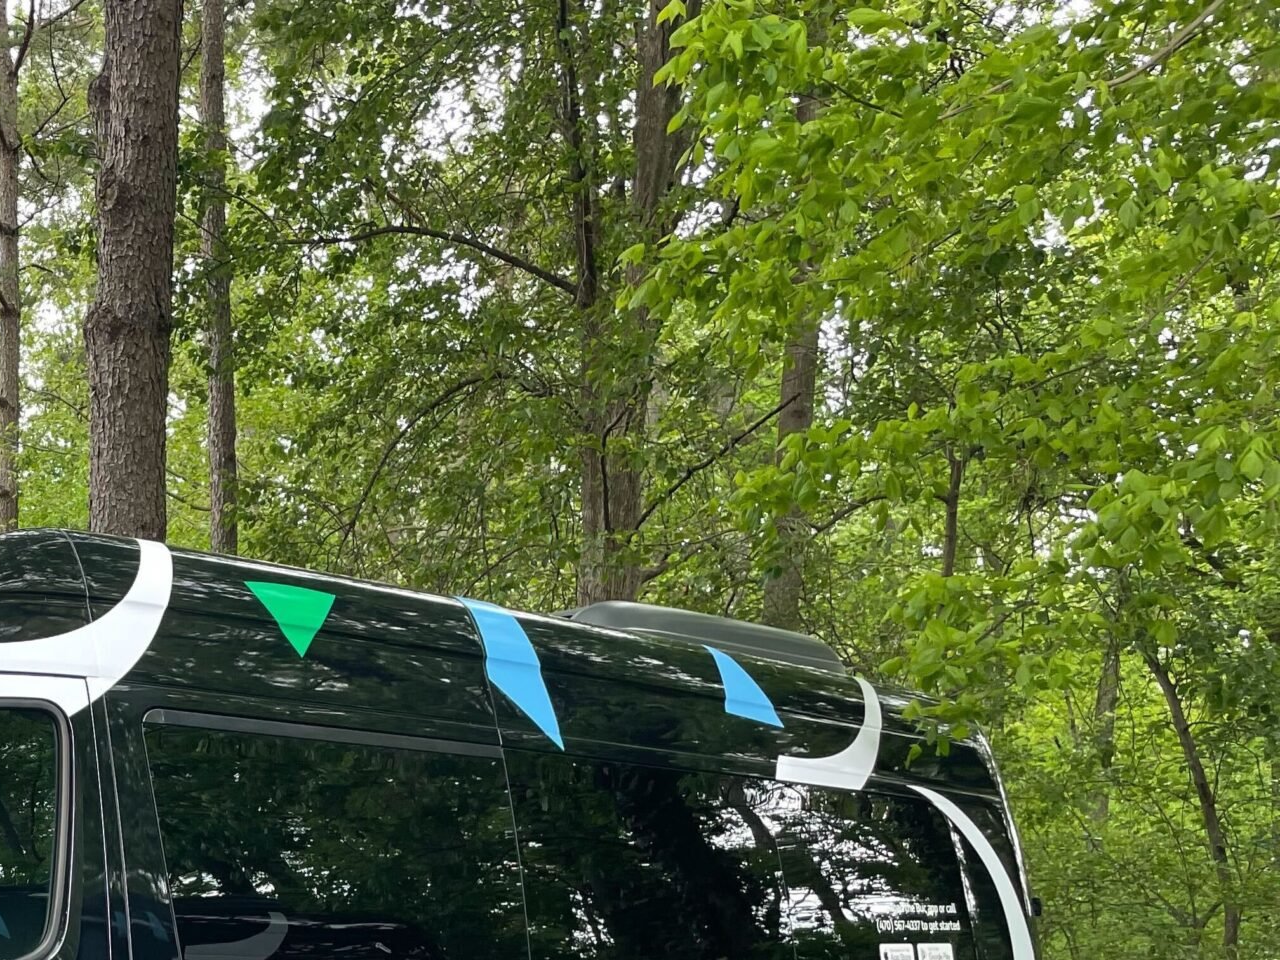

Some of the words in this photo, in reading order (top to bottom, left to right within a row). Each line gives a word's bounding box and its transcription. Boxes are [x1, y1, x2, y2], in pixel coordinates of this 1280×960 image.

[927, 905, 938, 917] app
[939, 905, 946, 914] or
[946, 902, 957, 914] call
[876, 918, 894, 934] (470)
[894, 920, 921, 931] 567-4337
[921, 920, 929, 931] to
[929, 920, 939, 934] get
[939, 920, 961, 931] started
